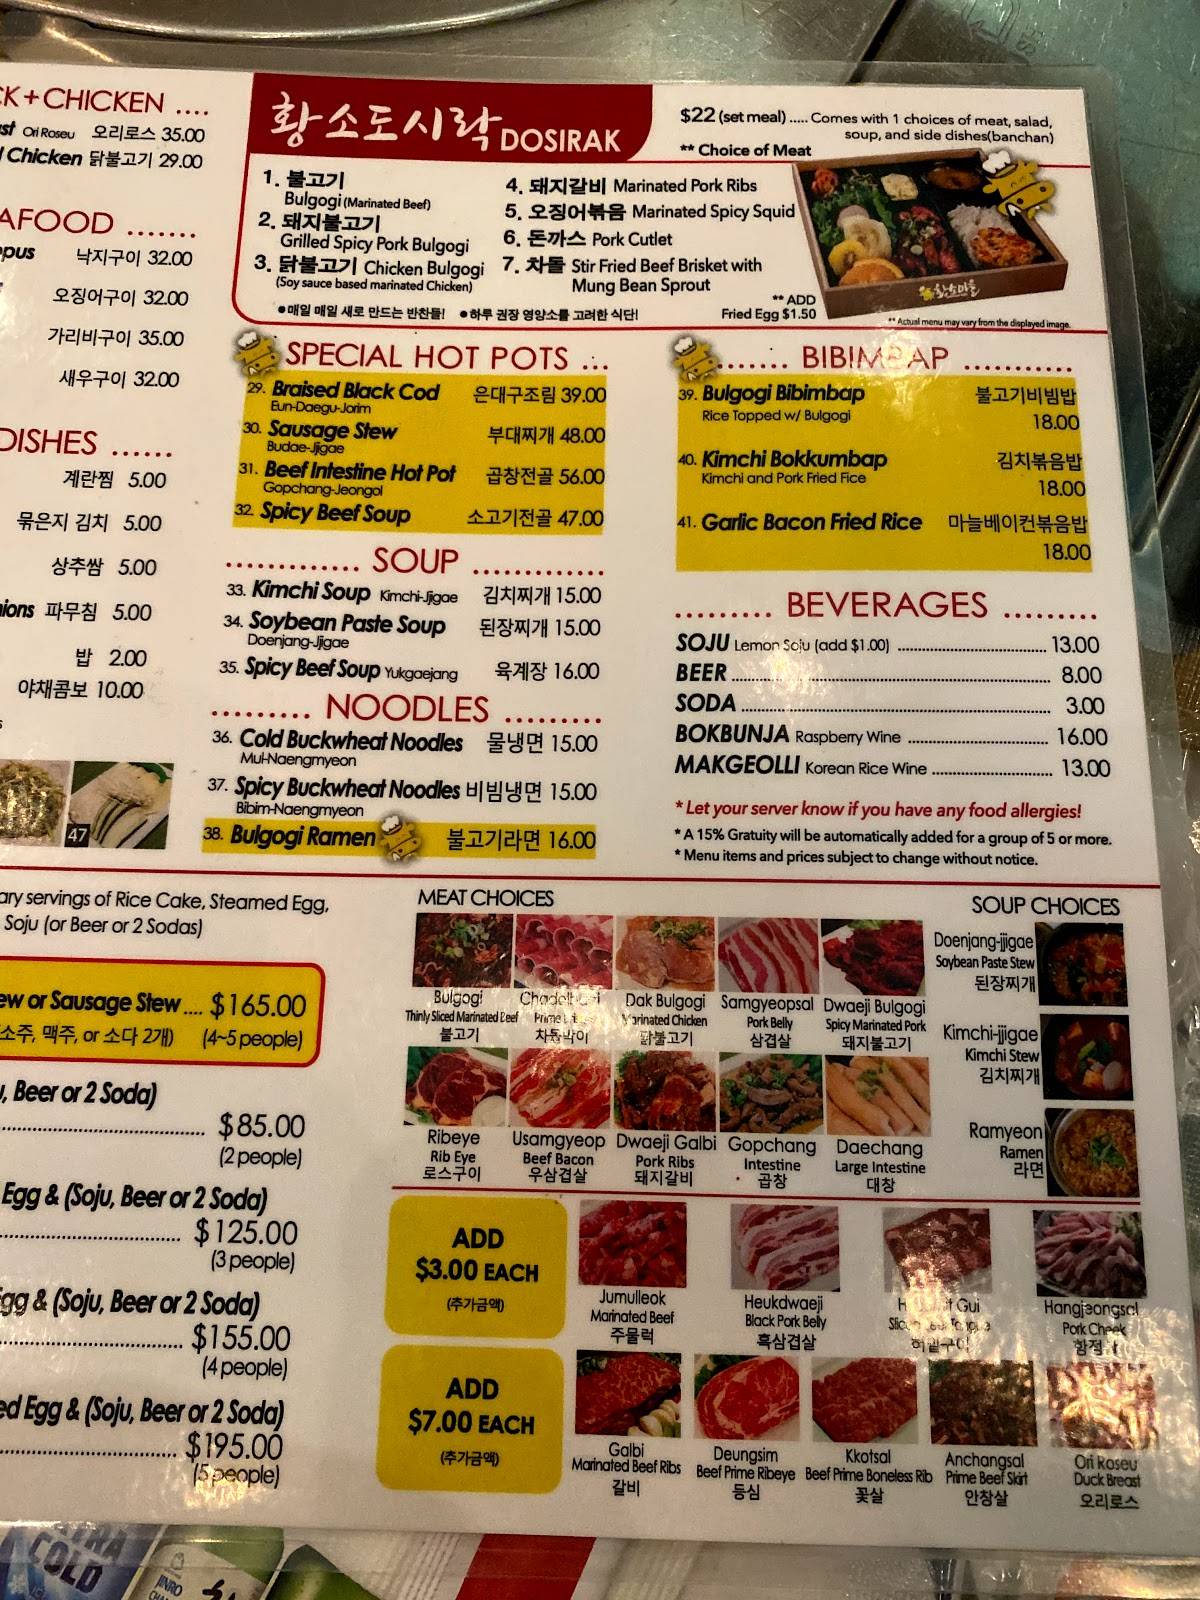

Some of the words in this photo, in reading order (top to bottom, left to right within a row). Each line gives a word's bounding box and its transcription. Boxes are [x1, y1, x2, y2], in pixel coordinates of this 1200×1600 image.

[681, 107, 715, 123] $22
[719, 110, 744, 124] (set
[747, 110, 786, 124] meal)
[811, 113, 857, 123] Comes
[861, 113, 888, 123] with
[894, 114, 898, 123] 1
[904, 114, 954, 124] choices
[958, 114, 971, 125] of
[975, 118, 1011, 128] meat,
[1015, 116, 1052, 129] salad,
[23, 127, 39, 137] Ori
[41, 128, 75, 139] Roseu
[92, 125, 155, 141] 오리로스
[162, 127, 205, 142] 35.00
[501, 129, 620, 152] DOSIRAK
[7, 147, 82, 165] Chicken
[160, 154, 202, 168] 29.00
[699, 144, 749, 156] Choice
[754, 144, 769, 156] of
[774, 144, 811, 156] Meat
[264, 170, 279, 186] 1.
[287, 170, 344, 189] 불고기
[506, 178, 522, 194] 4.
[530, 177, 605, 195] 돼지갈비
[285, 191, 341, 210] Bulgogi
[344, 197, 400, 208] (Marinated
[403, 199, 430, 210] Beef)
[77, 249, 140, 267] 낙지구이
[148, 250, 192, 266] 32.00
[276, 276, 299, 290] (Soy
[302, 280, 332, 288] sauce
[335, 278, 363, 290] based
[371, 280, 424, 291] marinated
[427, 281, 472, 293] Chicken)
[53, 288, 135, 307] 오징어구이
[144, 290, 188, 306] 32.00
[787, 295, 816, 305] ADD
[722, 308, 751, 319] Fried
[756, 309, 779, 322] Egg
[783, 308, 816, 319] $1.50
[898, 318, 920, 326] Actual
[945, 320, 960, 328] may
[961, 320, 976, 328] vary
[978, 318, 995, 327] from
[1010, 319, 1045, 330] displayed
[1047, 320, 1071, 331] image.
[48, 328, 130, 347] 가리비구이
[139, 330, 184, 346] 35.00
[286, 342, 402, 367] SPECIAL
[415, 346, 479, 369] HOT
[492, 347, 567, 370] POTS
[59, 370, 125, 388] 새우구이
[134, 371, 179, 387] 32.00
[243, 422, 261, 433] 30.
[268, 420, 349, 442] Sausage
[353, 422, 398, 439] Stew
[488, 427, 554, 444] 부대찌개
[560, 427, 605, 443] 48.00
[678, 454, 696, 465] 40.
[703, 450, 766, 467] Kimchi
[771, 450, 887, 471] Bokkumbap
[998, 452, 1082, 471] 김치볶음밥
[64, 470, 113, 488] 계란찜
[129, 472, 166, 488] 5.00
[702, 473, 743, 484] Kimchi
[747, 473, 773, 483] and
[777, 472, 803, 483] Pork
[807, 472, 836, 483] Fried
[841, 472, 866, 483] Fice
[1040, 480, 1085, 496] 18.00
[76, 514, 108, 532] 김치
[124, 515, 161, 531] 5.00
[52, 557, 104, 576] 상추쌈
[119, 559, 156, 575] 5.00
[373, 547, 458, 574] SOUP
[227, 584, 246, 596] 33.
[252, 580, 319, 599] Kimchi
[322, 582, 371, 605] Soup
[484, 586, 550, 605] 김치찌개
[557, 587, 601, 603] 15.00
[45, 602, 97, 621] 파무침
[113, 604, 151, 621] 5.00
[789, 592, 987, 618] BEVERAGES
[76, 648, 92, 667] 밥
[109, 650, 147, 666] 2.00
[19, 679, 87, 699] 야채콤보
[99, 681, 143, 699] 10.00
[327, 694, 488, 722] NOODLES
[675, 693, 736, 712] SODA
[1067, 697, 1104, 714] 3.00
[676, 724, 789, 743] BOKBUNJA
[796, 731, 863, 745] Raspberry
[867, 731, 901, 743] Wine
[1058, 728, 1107, 745] 16.00
[687, 800, 710, 814] Let
[712, 805, 748, 819] your
[751, 805, 798, 815] server
[802, 800, 844, 815] know
[848, 801, 859, 815] if
[861, 806, 890, 820] you
[895, 801, 932, 816] have
[937, 807, 965, 821] any
[969, 802, 1007, 817] food
[1011, 803, 1081, 822] allergies!
[68, 829, 87, 841] 47
[203, 827, 223, 840] 38.
[231, 824, 304, 850] Bulgogi
[307, 826, 376, 846] Ramen
[447, 829, 539, 851] 불고기라면
[550, 831, 596, 849] 16.00
[685, 849, 719, 861] Menu
[723, 850, 756, 861] items
[760, 850, 783, 861] and
[787, 854, 824, 865] prices
[828, 850, 873, 866] subject
[876, 853, 889, 863] to
[893, 851, 940, 867] change
[943, 852, 992, 864] without
[996, 853, 1037, 865] notice.
[418, 889, 467, 905] MEAT
[471, 889, 554, 907] CHOICES
[972, 896, 1025, 914] SOUP
[1031, 897, 1120, 915] CHOICES
[5, 915, 38, 934] Soju
[45, 915, 67, 935] (or
[71, 917, 108, 932] Beer
[112, 921, 129, 933] or
[133, 918, 142, 933] 2
[147, 918, 202, 938] Sodas)
[210, 992, 306, 1020] $165.00
[203, 1029, 236, 1049] (4~5
[240, 1031, 302, 1051] people)
[966, 1048, 1006, 1061] Kimchi
[1010, 1049, 1039, 1062] Stew
[219, 1112, 305, 1141] $85.00
[970, 1122, 1042, 1142] Ramyeon
[428, 1129, 480, 1147] Ribeye
[513, 1131, 605, 1151] Usamgyeop
[617, 1133, 669, 1153] Dwaeji
[675, 1135, 716, 1150] Galbi
[837, 1139, 922, 1159] Daechang
[423, 1167, 480, 1182] 로스구이
[452, 1228, 504, 1249] ADD
[416, 1256, 478, 1282] $3.00
[485, 1263, 538, 1282] EACH
[408, 1408, 472, 1435] $7.00
[479, 1415, 534, 1434] EACH
[846, 1449, 890, 1463] Kkotsal
[965, 1490, 1008, 1506] 안창살
[30, 1534, 102, 1593] COLD
[157, 1574, 183, 1598] JINRO
